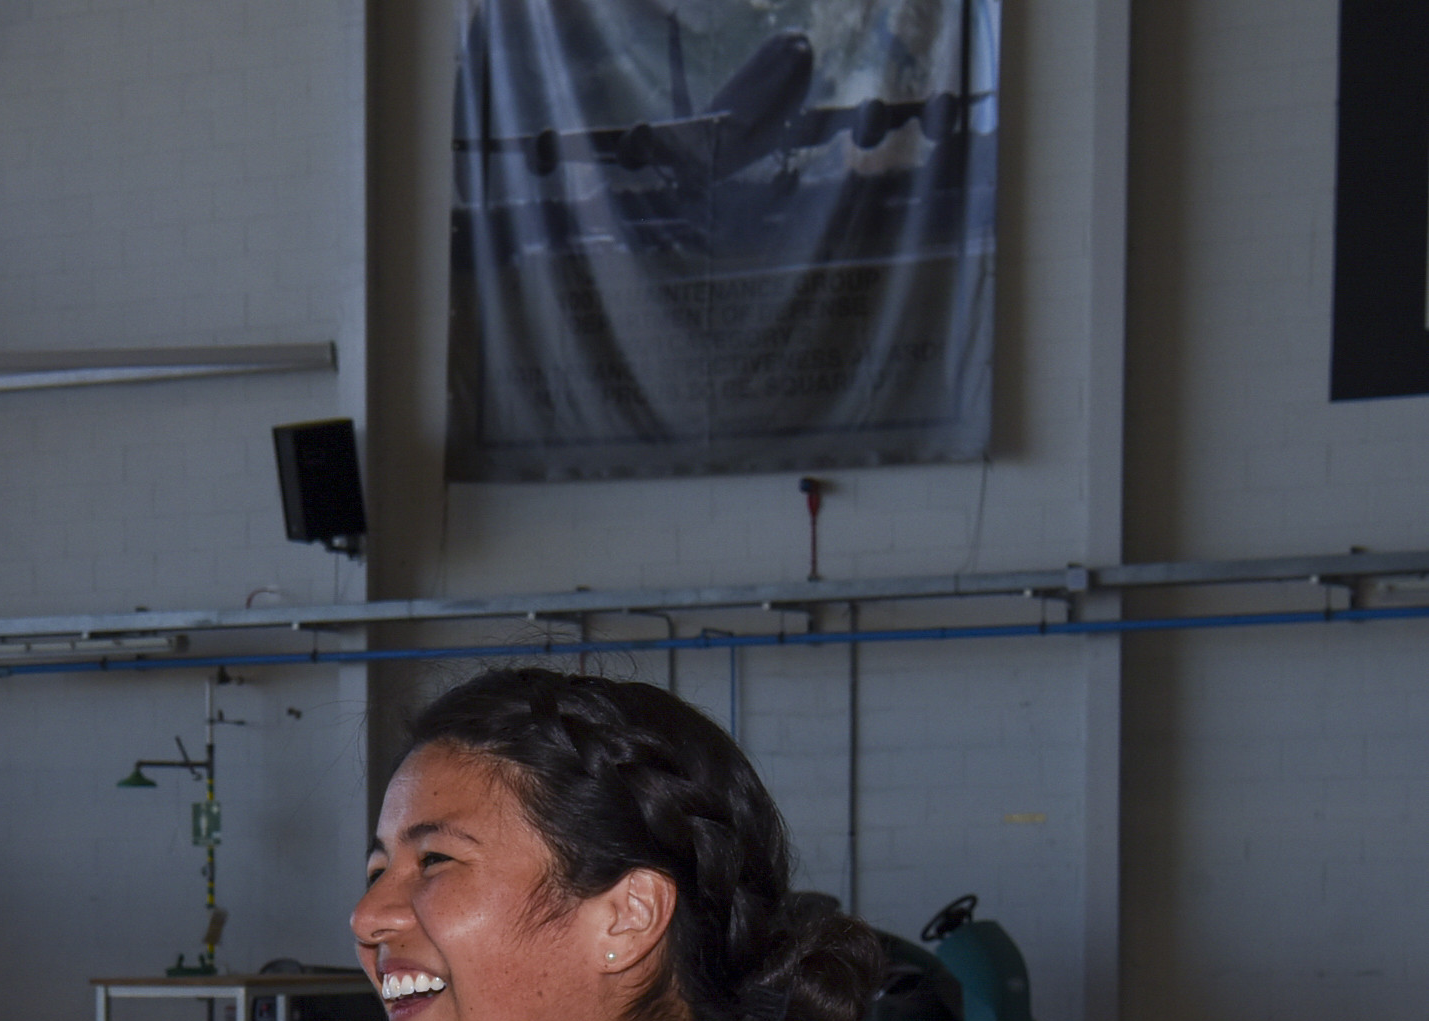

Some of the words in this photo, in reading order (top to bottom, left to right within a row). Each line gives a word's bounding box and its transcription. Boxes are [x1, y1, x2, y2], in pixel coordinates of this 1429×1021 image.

[794, 270, 881, 296] GROUP
[722, 304, 749, 326] OF
[760, 295, 869, 323] DEFENSE
